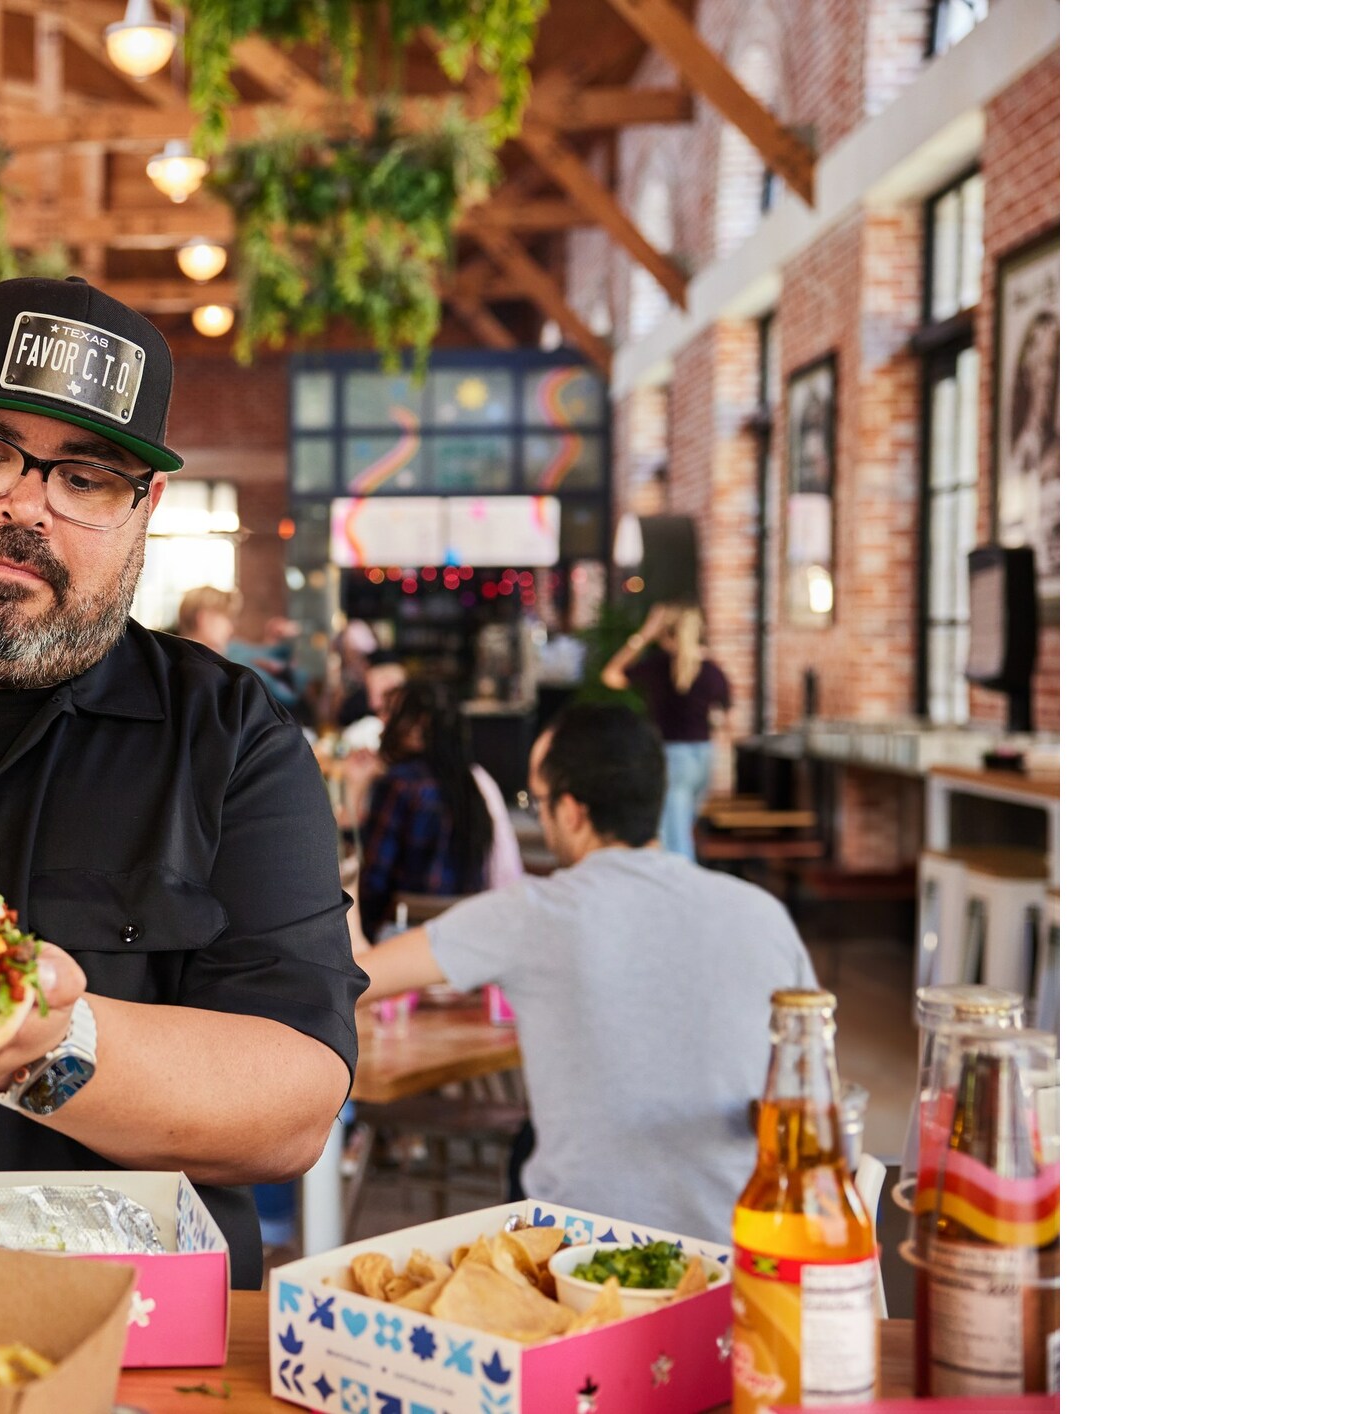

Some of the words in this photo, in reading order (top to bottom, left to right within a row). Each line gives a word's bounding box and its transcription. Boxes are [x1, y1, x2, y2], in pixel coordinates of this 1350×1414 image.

[62, 326, 109, 348] TEXAS
[15, 333, 80, 375] FAVOR
[82, 349, 130, 397] C.T.O.
